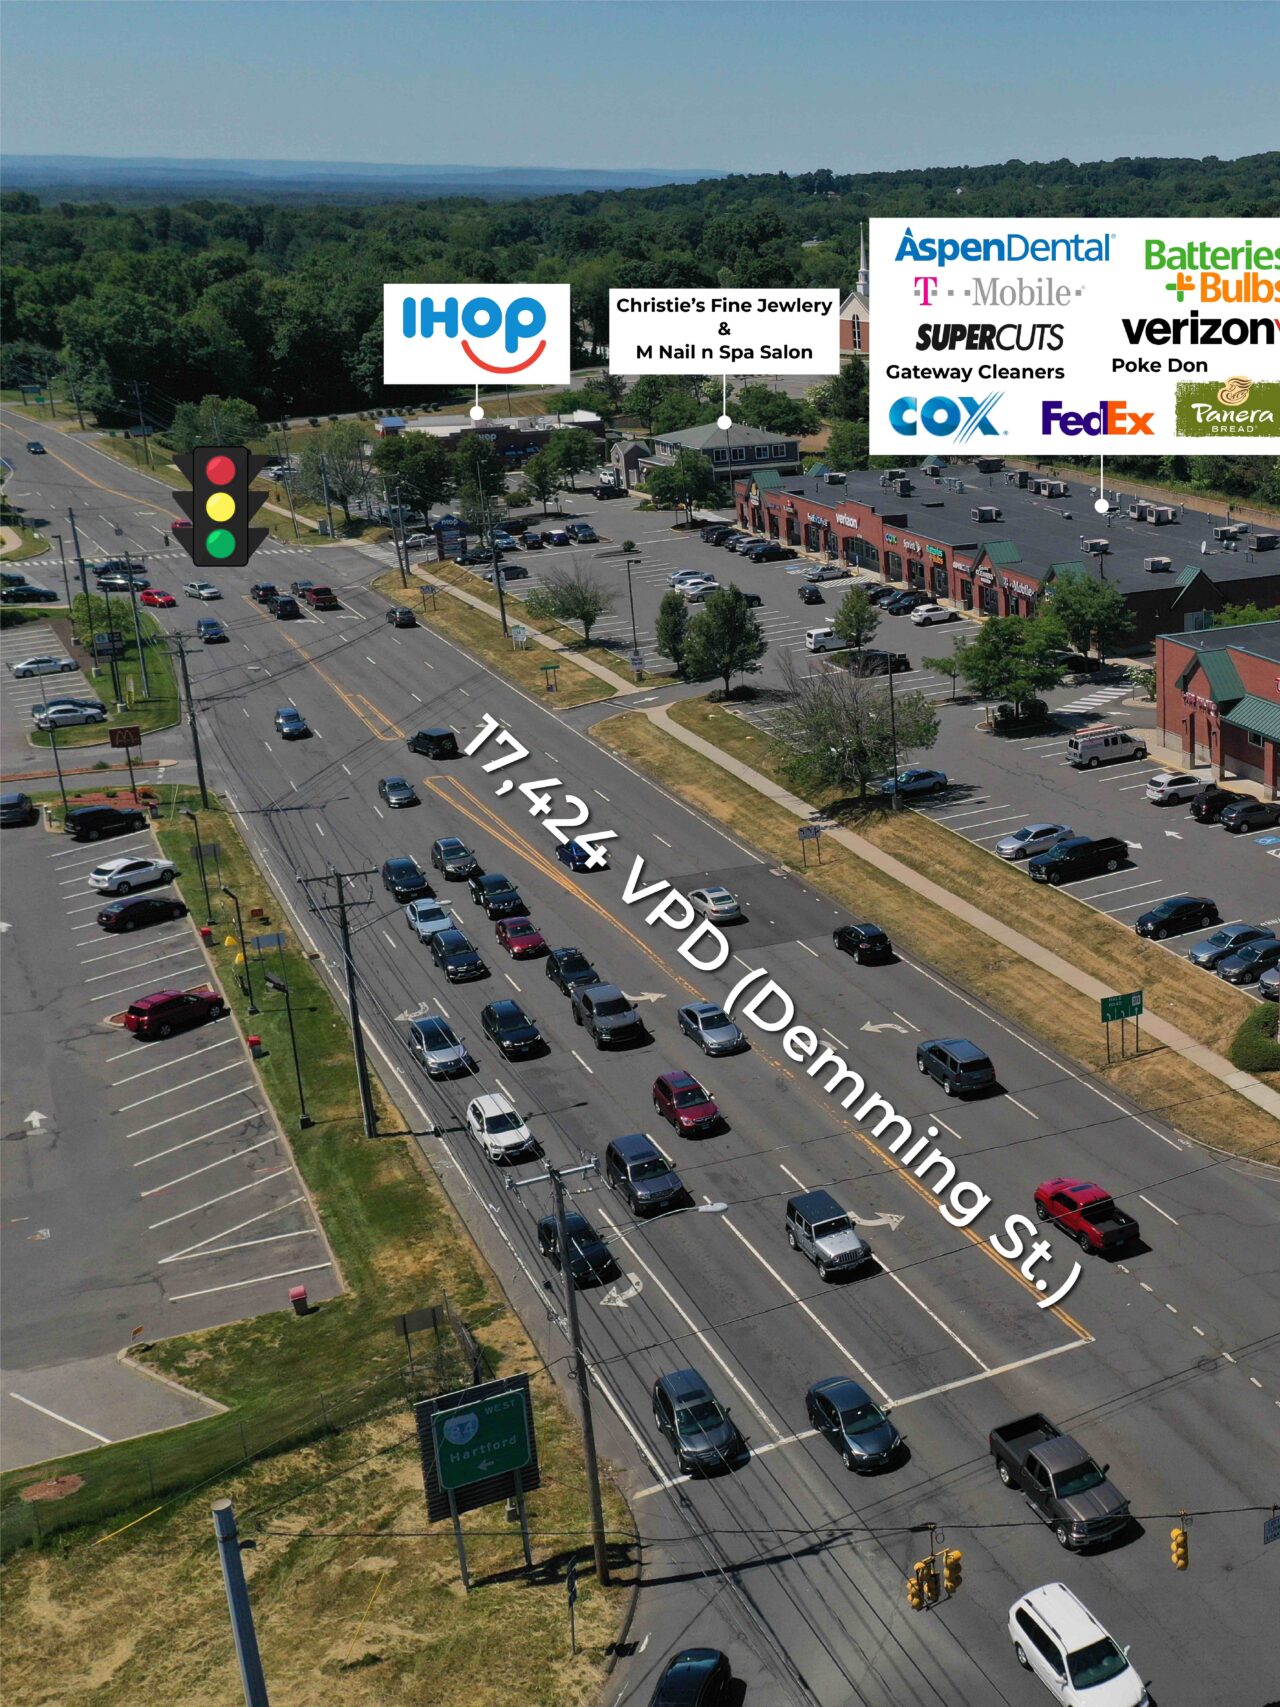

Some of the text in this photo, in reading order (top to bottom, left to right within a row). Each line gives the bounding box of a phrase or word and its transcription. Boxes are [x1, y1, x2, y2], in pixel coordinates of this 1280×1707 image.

[836, 513, 858, 529] verizon
[452, 1399, 516, 1437] 84 WEST
[450, 1436, 517, 1463] Hartford
